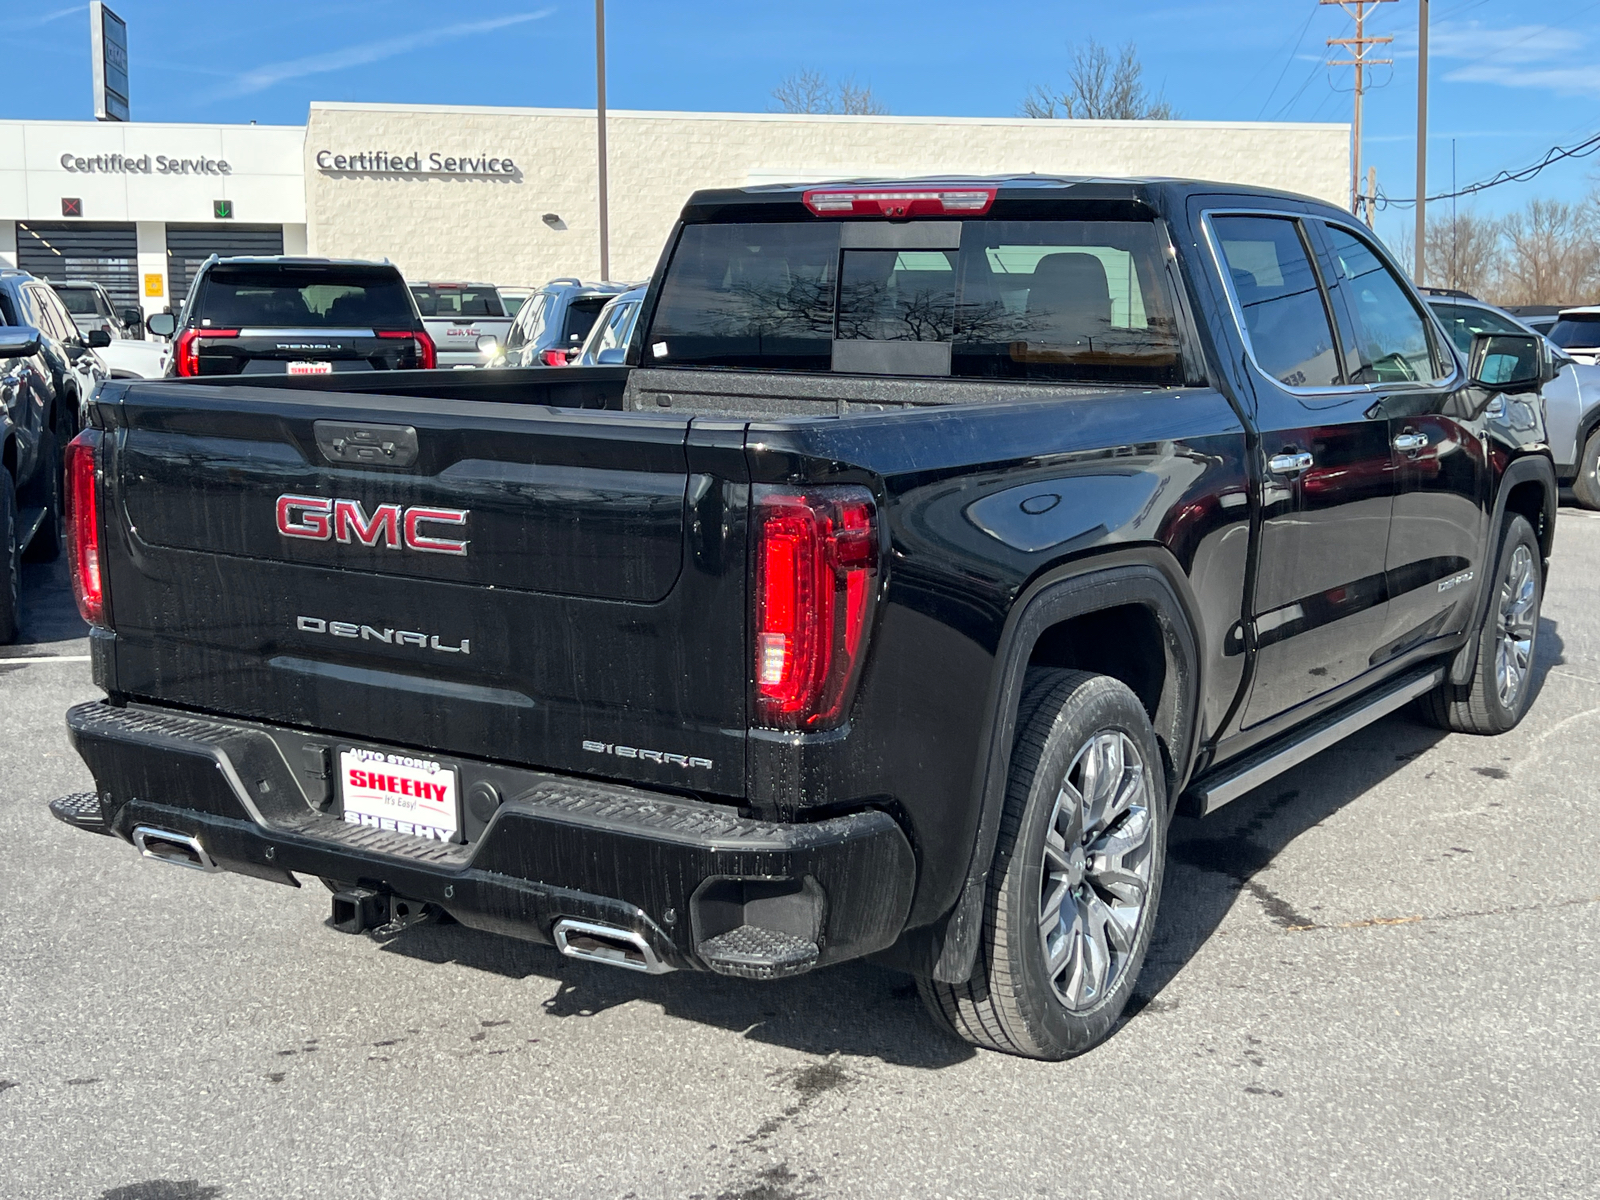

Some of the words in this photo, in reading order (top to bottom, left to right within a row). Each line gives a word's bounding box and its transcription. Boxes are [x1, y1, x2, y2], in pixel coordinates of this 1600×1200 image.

[60, 153, 148, 171] Certified
[156, 155, 229, 173] Service
[316, 149, 418, 171] Certified
[428, 152, 514, 172] Service
[446, 328, 482, 337] GMC
[276, 493, 469, 556] GMC
[297, 615, 470, 654] DENALI
[349, 748, 385, 763] AUTO
[387, 755, 441, 772] STORES
[582, 740, 713, 770] SIERRA
[349, 769, 447, 802] SHEEHY
[384, 795, 396, 806] It's
[397, 797, 417, 811] Easy!
[344, 811, 455, 842] SHEEHY
